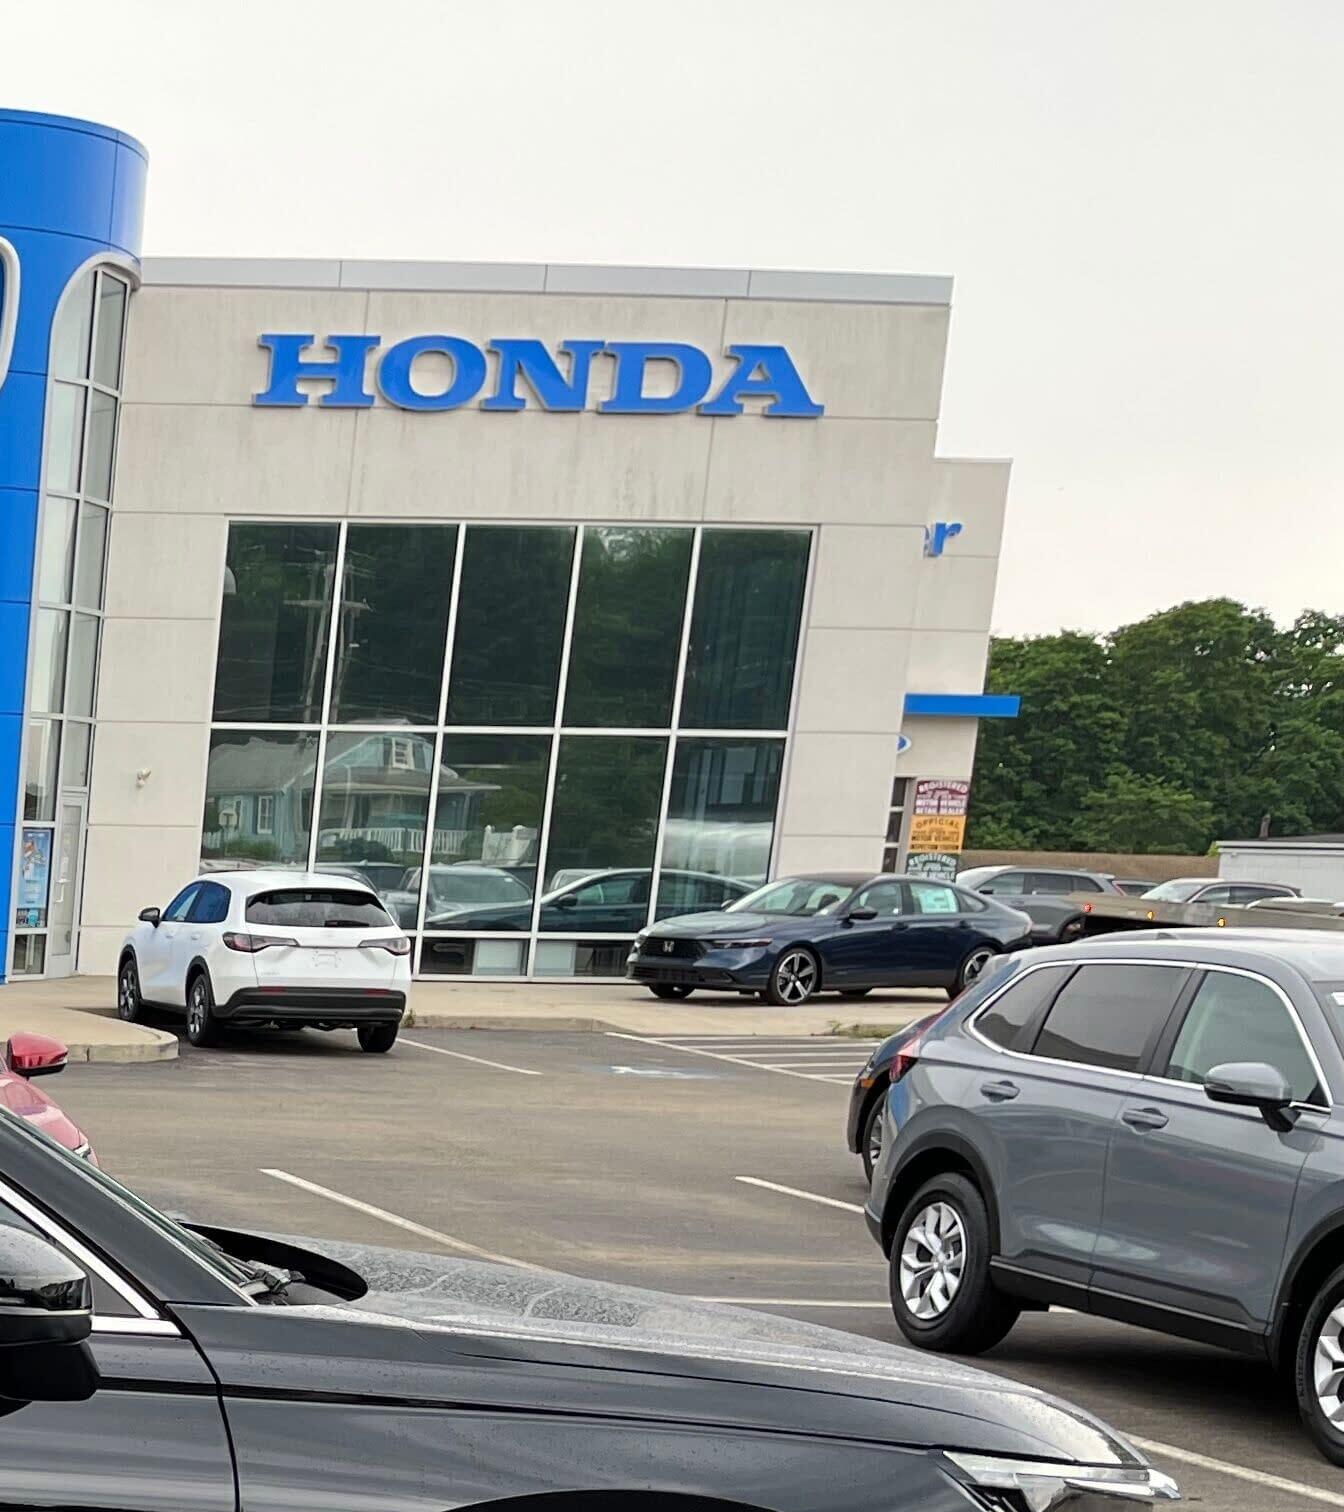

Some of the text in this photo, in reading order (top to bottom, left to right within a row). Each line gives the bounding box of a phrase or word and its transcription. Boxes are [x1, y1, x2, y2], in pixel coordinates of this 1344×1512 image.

[252, 333, 825, 418] HONDA
[923, 522, 962, 558] r
[916, 817, 959, 828] OFFICIAL
